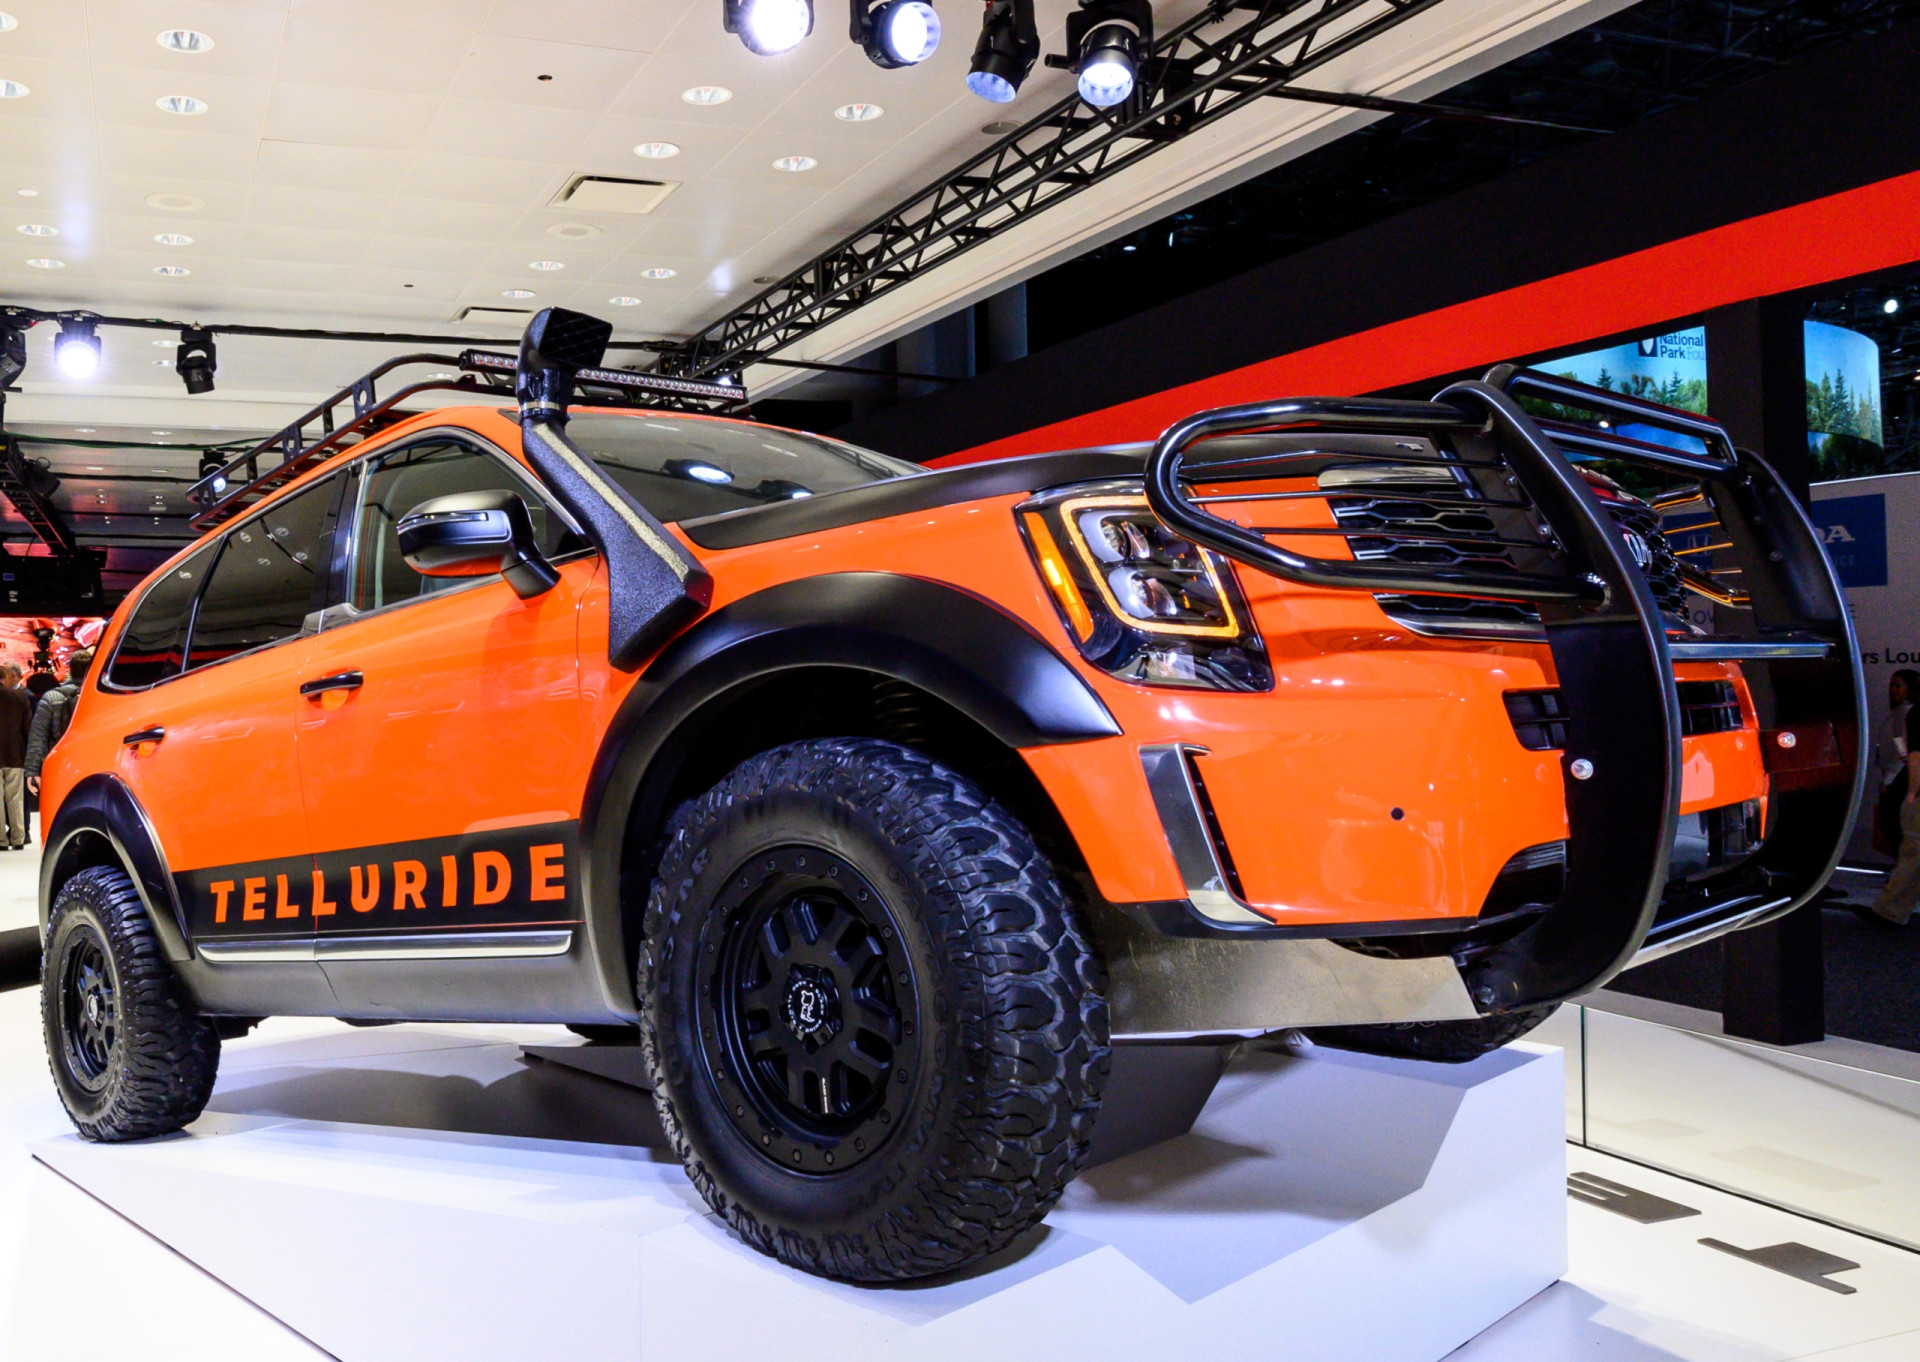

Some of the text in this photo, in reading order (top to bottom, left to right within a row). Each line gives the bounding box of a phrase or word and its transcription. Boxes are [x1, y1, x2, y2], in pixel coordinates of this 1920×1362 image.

[1660, 333, 1703, 346] National
[1660, 345, 1686, 359] Park
[1886, 648, 1920, 664] Lou
[209, 843, 565, 923] TELLURIDE
